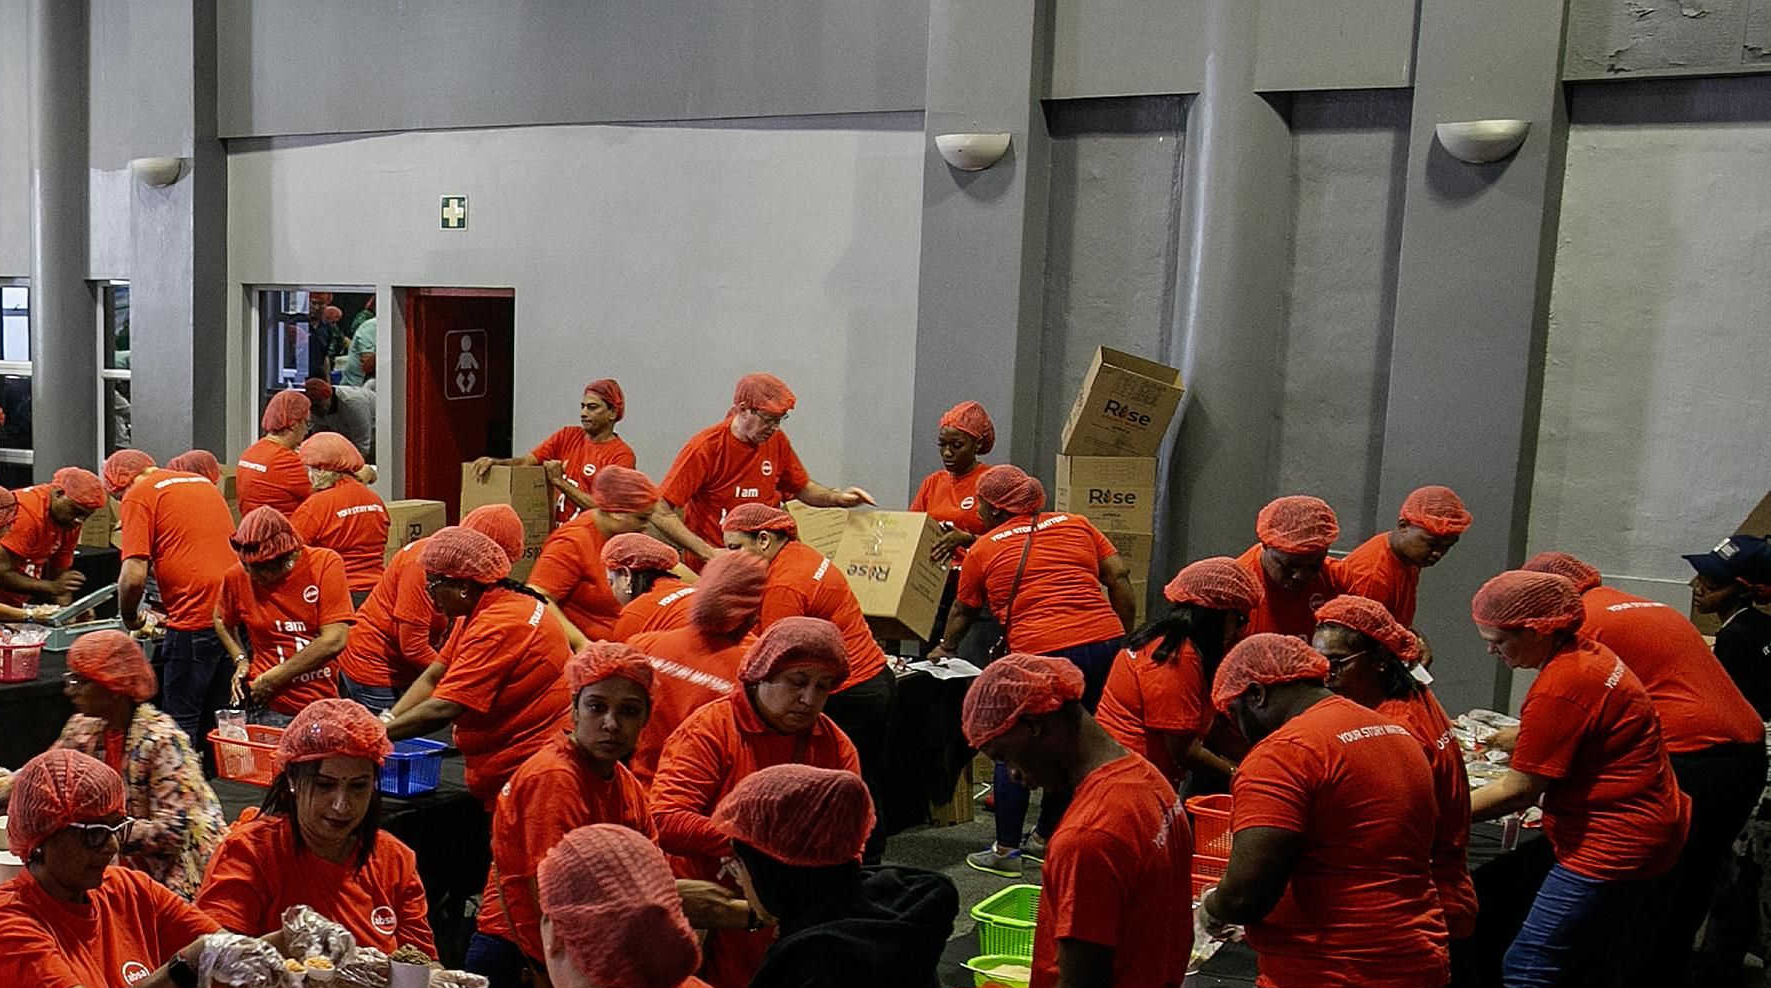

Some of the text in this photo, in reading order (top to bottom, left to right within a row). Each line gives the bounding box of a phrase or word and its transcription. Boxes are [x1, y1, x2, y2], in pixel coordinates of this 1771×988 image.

[1104, 399, 1151, 427] Rise
[735, 486, 759, 498] I am
[1088, 488, 1136, 505] Rise
[284, 621, 307, 632] am
[1336, 728, 1365, 744] YOUR
[1361, 725, 1386, 739] STORY
